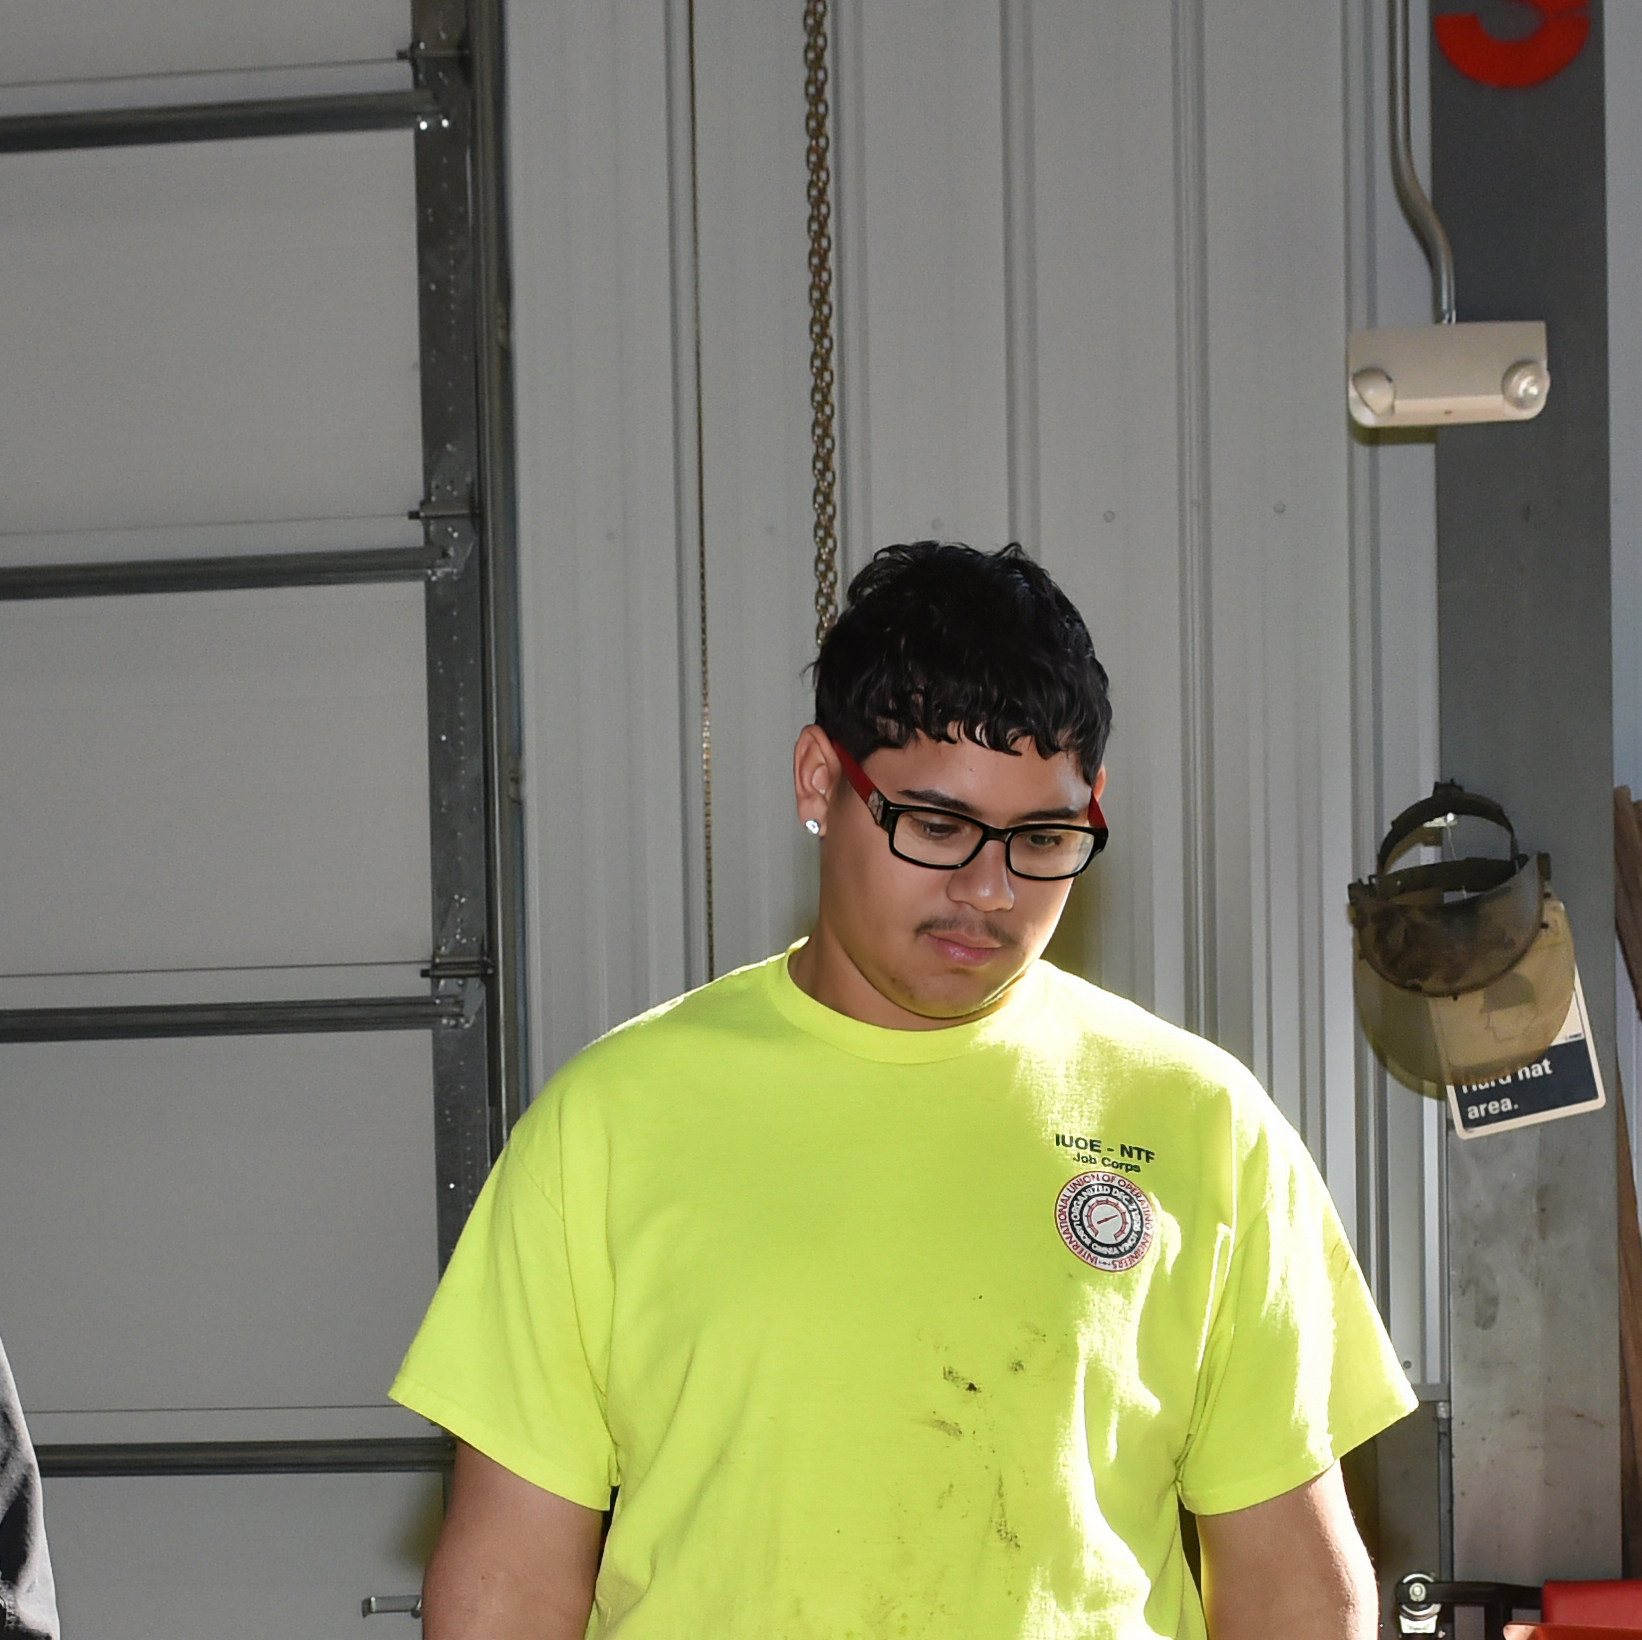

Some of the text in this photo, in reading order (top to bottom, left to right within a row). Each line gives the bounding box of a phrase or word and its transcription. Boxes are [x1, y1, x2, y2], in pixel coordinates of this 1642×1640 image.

[1467, 1097, 1519, 1120] area.
[1055, 1133, 1102, 1154] IUOE
[1120, 1143, 1156, 1164] NTF
[1073, 1152, 1141, 1174] Job Corps
[1057, 1173, 1153, 1269] INTERNATIONAL UNION OF OPERATING ENGINEERS
